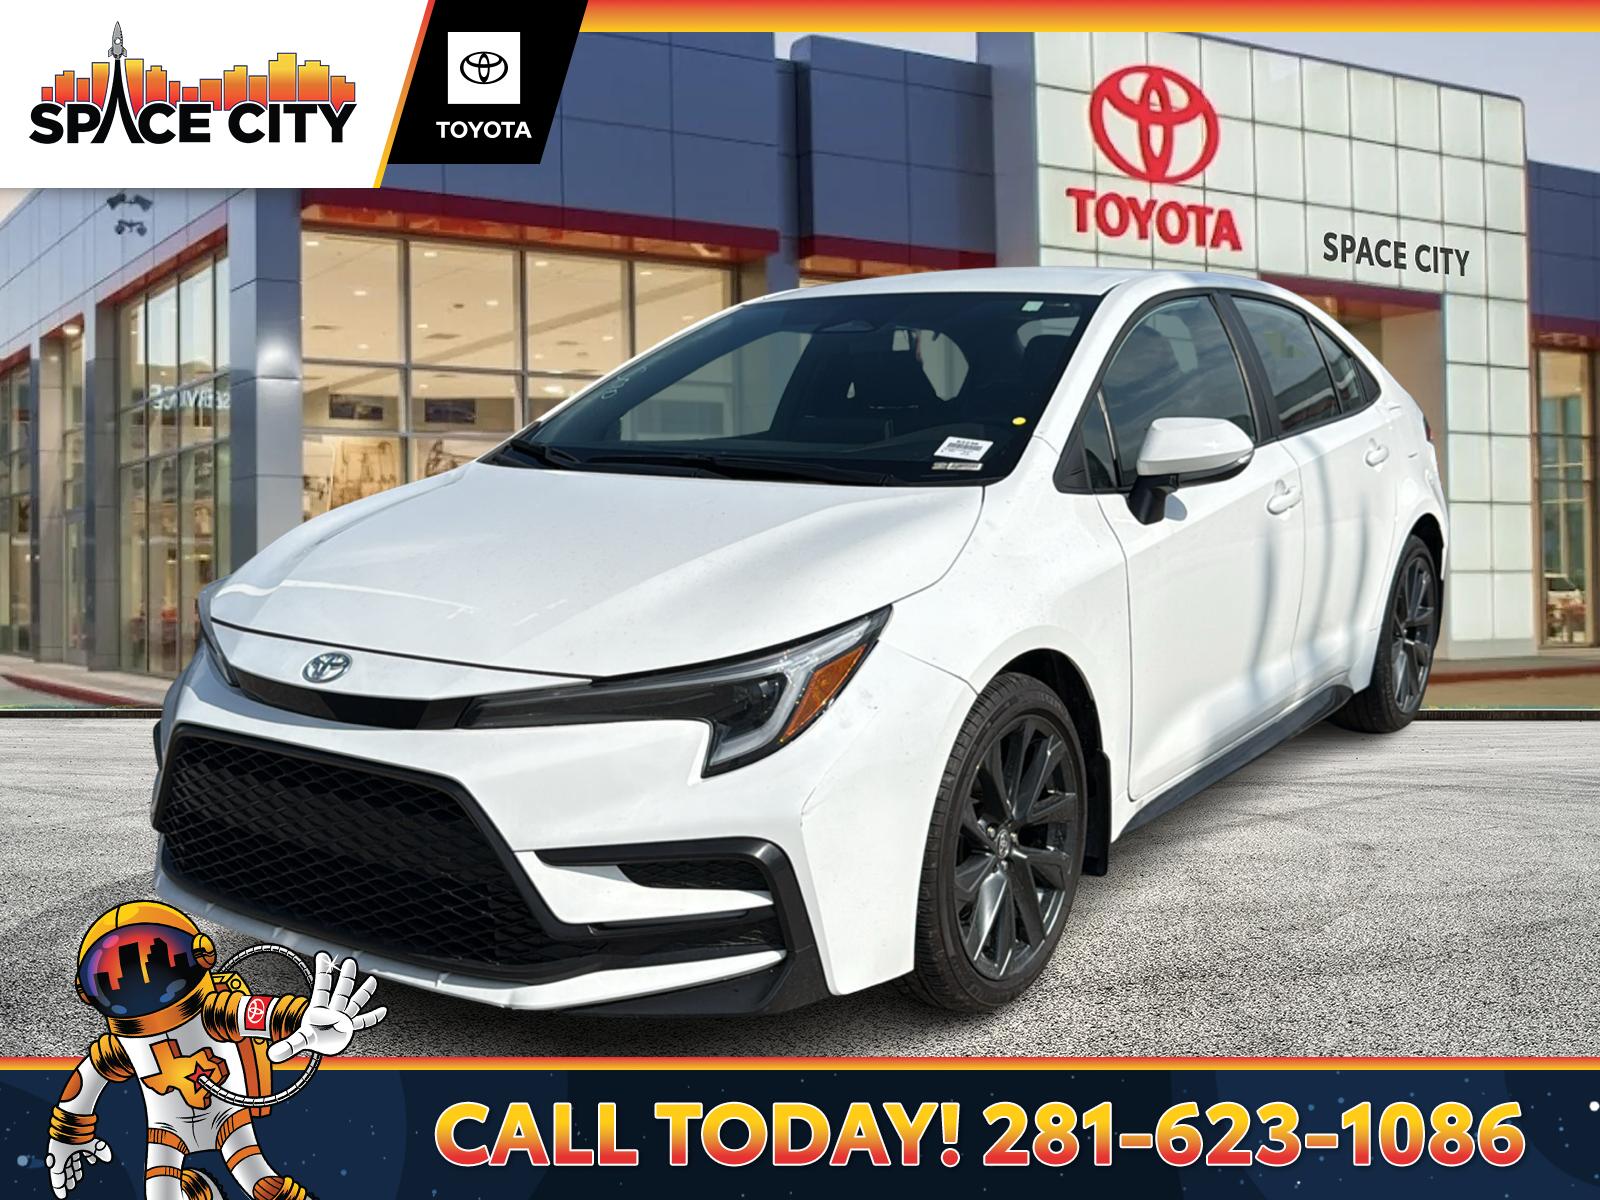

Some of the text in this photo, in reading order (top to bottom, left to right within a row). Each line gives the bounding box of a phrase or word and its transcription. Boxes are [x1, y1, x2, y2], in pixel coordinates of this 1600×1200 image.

[1066, 187, 1243, 252] TOYOTA
[1323, 231, 1471, 277] SPACE CITY
